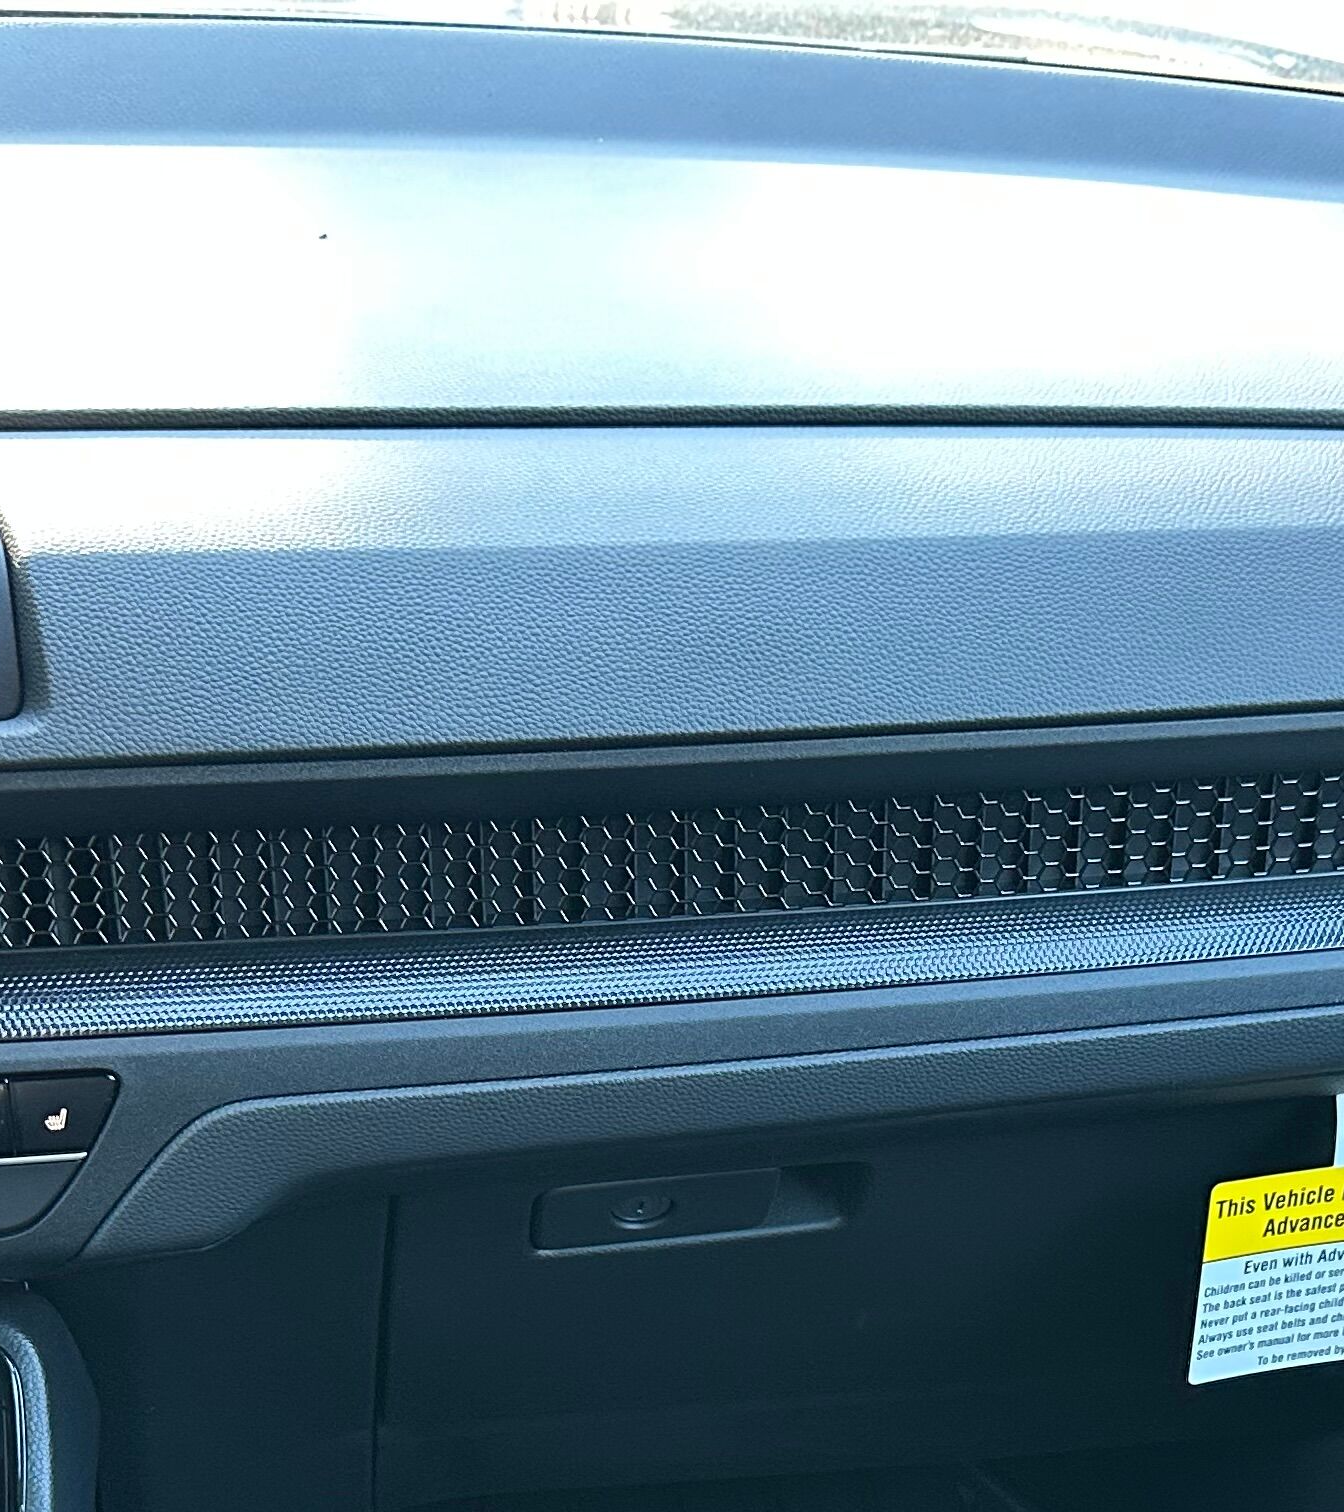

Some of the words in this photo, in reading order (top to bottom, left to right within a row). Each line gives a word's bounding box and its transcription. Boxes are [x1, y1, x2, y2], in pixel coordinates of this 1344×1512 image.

[1215, 1197, 1256, 1220] This
[1263, 1184, 1335, 1212] Vehicle
[1244, 1259, 1278, 1274] Even
[1283, 1251, 1313, 1268] with
[1202, 1302, 1220, 1313] The
[1223, 1296, 1246, 1310] back
[1249, 1292, 1271, 1305] seat
[1274, 1291, 1283, 1301] is
[1286, 1288, 1302, 1299] the
[1305, 1282, 1336, 1297] safest
[1204, 1283, 1245, 1298] Children
[1248, 1279, 1266, 1290] can
[1268, 1276, 1281, 1287] be
[1284, 1271, 1312, 1283] killed
[1315, 1270, 1326, 1279] or
[1200, 1315, 1230, 1330] Never
[1232, 1310, 1248, 1326] put
[1250, 1310, 1257, 1320] a
[1260, 1301, 1316, 1318] rear-facing
[1318, 1296, 1344, 1310] child
[1196, 1349, 1215, 1361] See
[1217, 1340, 1255, 1357] owner's
[1257, 1333, 1294, 1348] manual
[1297, 1331, 1312, 1342] for
[1313, 1328, 1339, 1341] more
[1198, 1329, 1234, 1346] Always
[1236, 1326, 1253, 1338] use
[1256, 1321, 1279, 1334] seat
[1281, 1317, 1306, 1330] belts
[1308, 1314, 1328, 1326] and
[1257, 1355, 1269, 1366] To
[1271, 1352, 1284, 1364] be
[1286, 1345, 1331, 1361] removed
